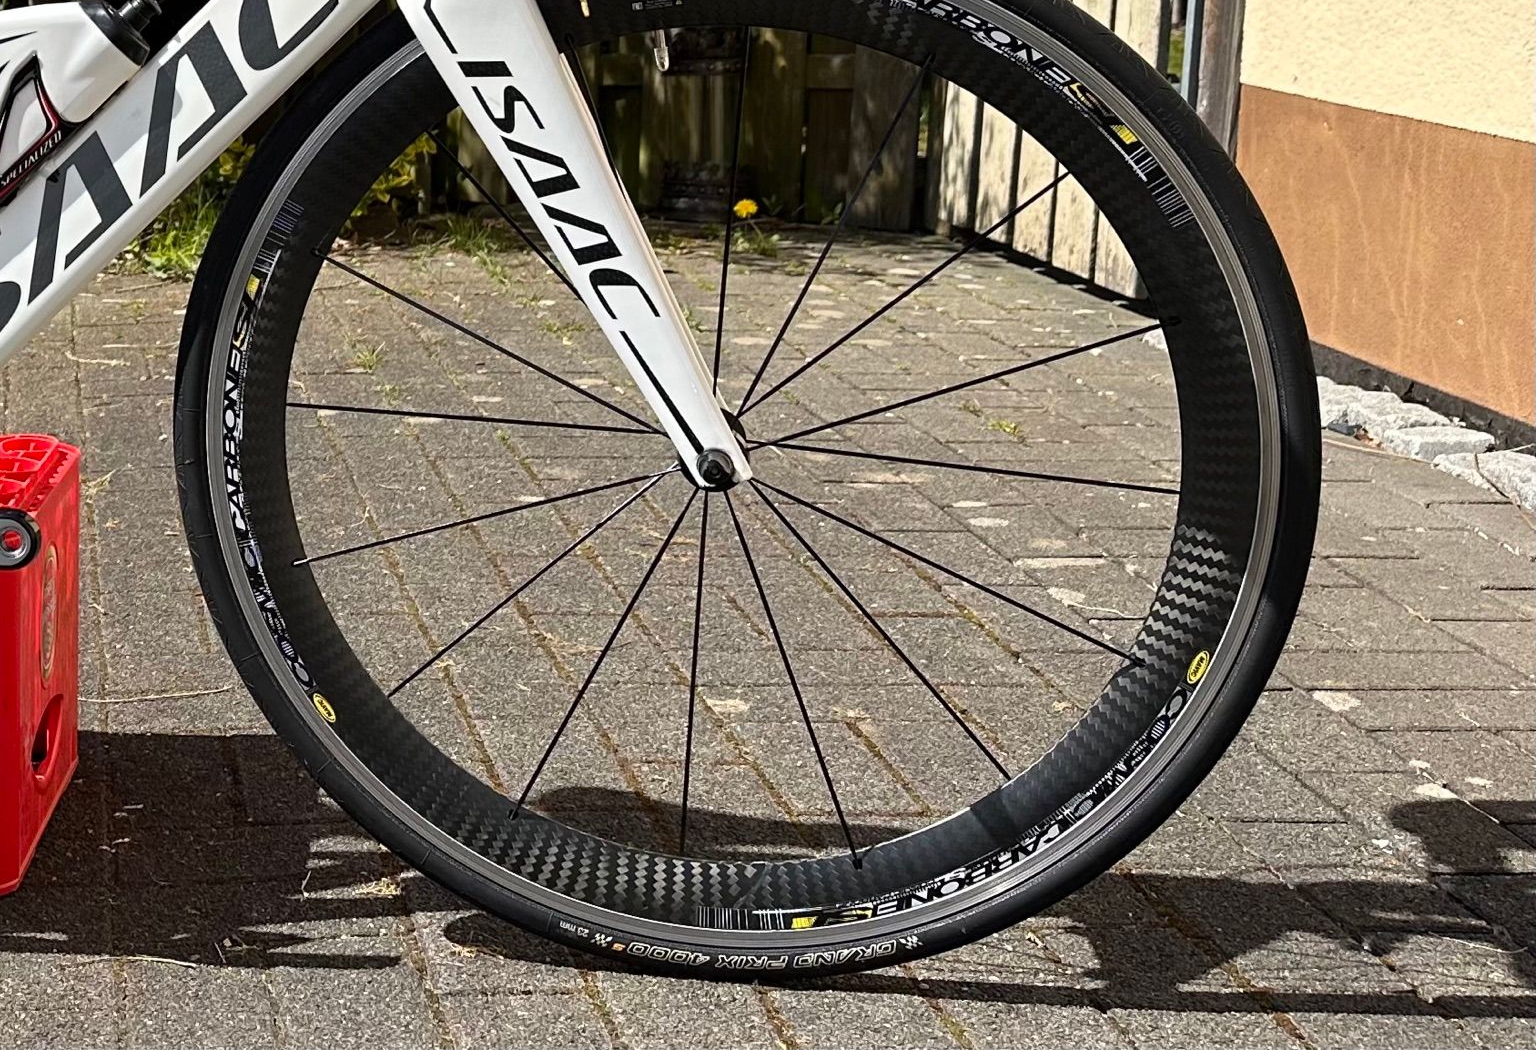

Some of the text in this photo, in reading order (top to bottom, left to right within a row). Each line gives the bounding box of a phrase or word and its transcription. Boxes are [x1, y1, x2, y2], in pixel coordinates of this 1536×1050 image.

[457, 60, 661, 320] ISAAC
[714, 952, 789, 970] PRIX
[791, 937, 899, 970] GRAND
